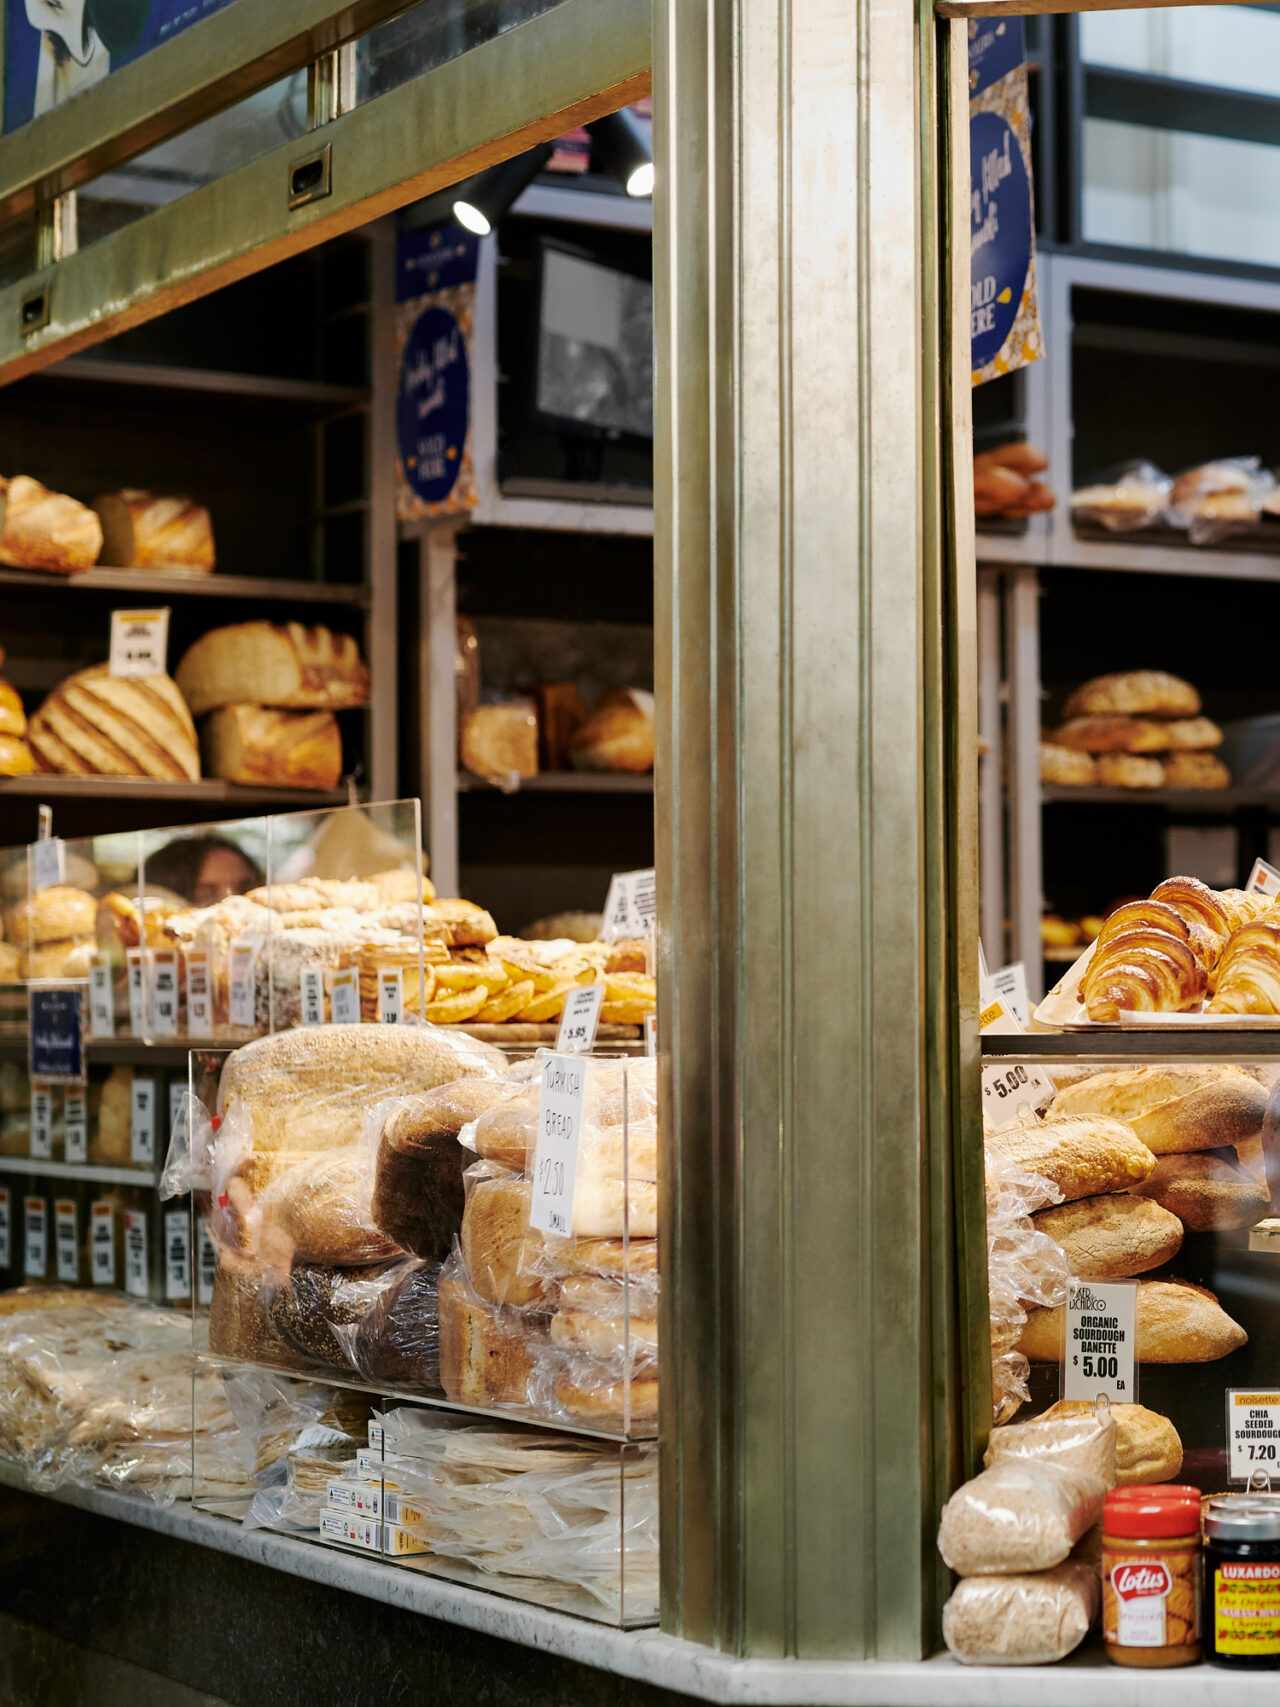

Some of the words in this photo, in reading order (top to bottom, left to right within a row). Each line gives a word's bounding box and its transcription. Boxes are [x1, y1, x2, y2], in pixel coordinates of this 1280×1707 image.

[971, 307, 996, 339] ERE
[544, 1060, 580, 1095] TURKISH
[993, 1065, 1029, 1098] 5.00
[545, 1108, 573, 1140] BREAD
[1081, 1315, 1119, 1329] ORGANIC
[1073, 1328, 1125, 1342] SOURDOUGH
[1081, 1341, 1117, 1354] BANETTE
[1083, 1356, 1118, 1378] 5.00
[1116, 1380, 1125, 1390] EA
[1249, 1409, 1269, 1419] CHIA
[1245, 1420, 1273, 1429] SEEDED
[1248, 1444, 1276, 1460] 7.20
[1223, 1566, 1280, 1579] LUXARDO
